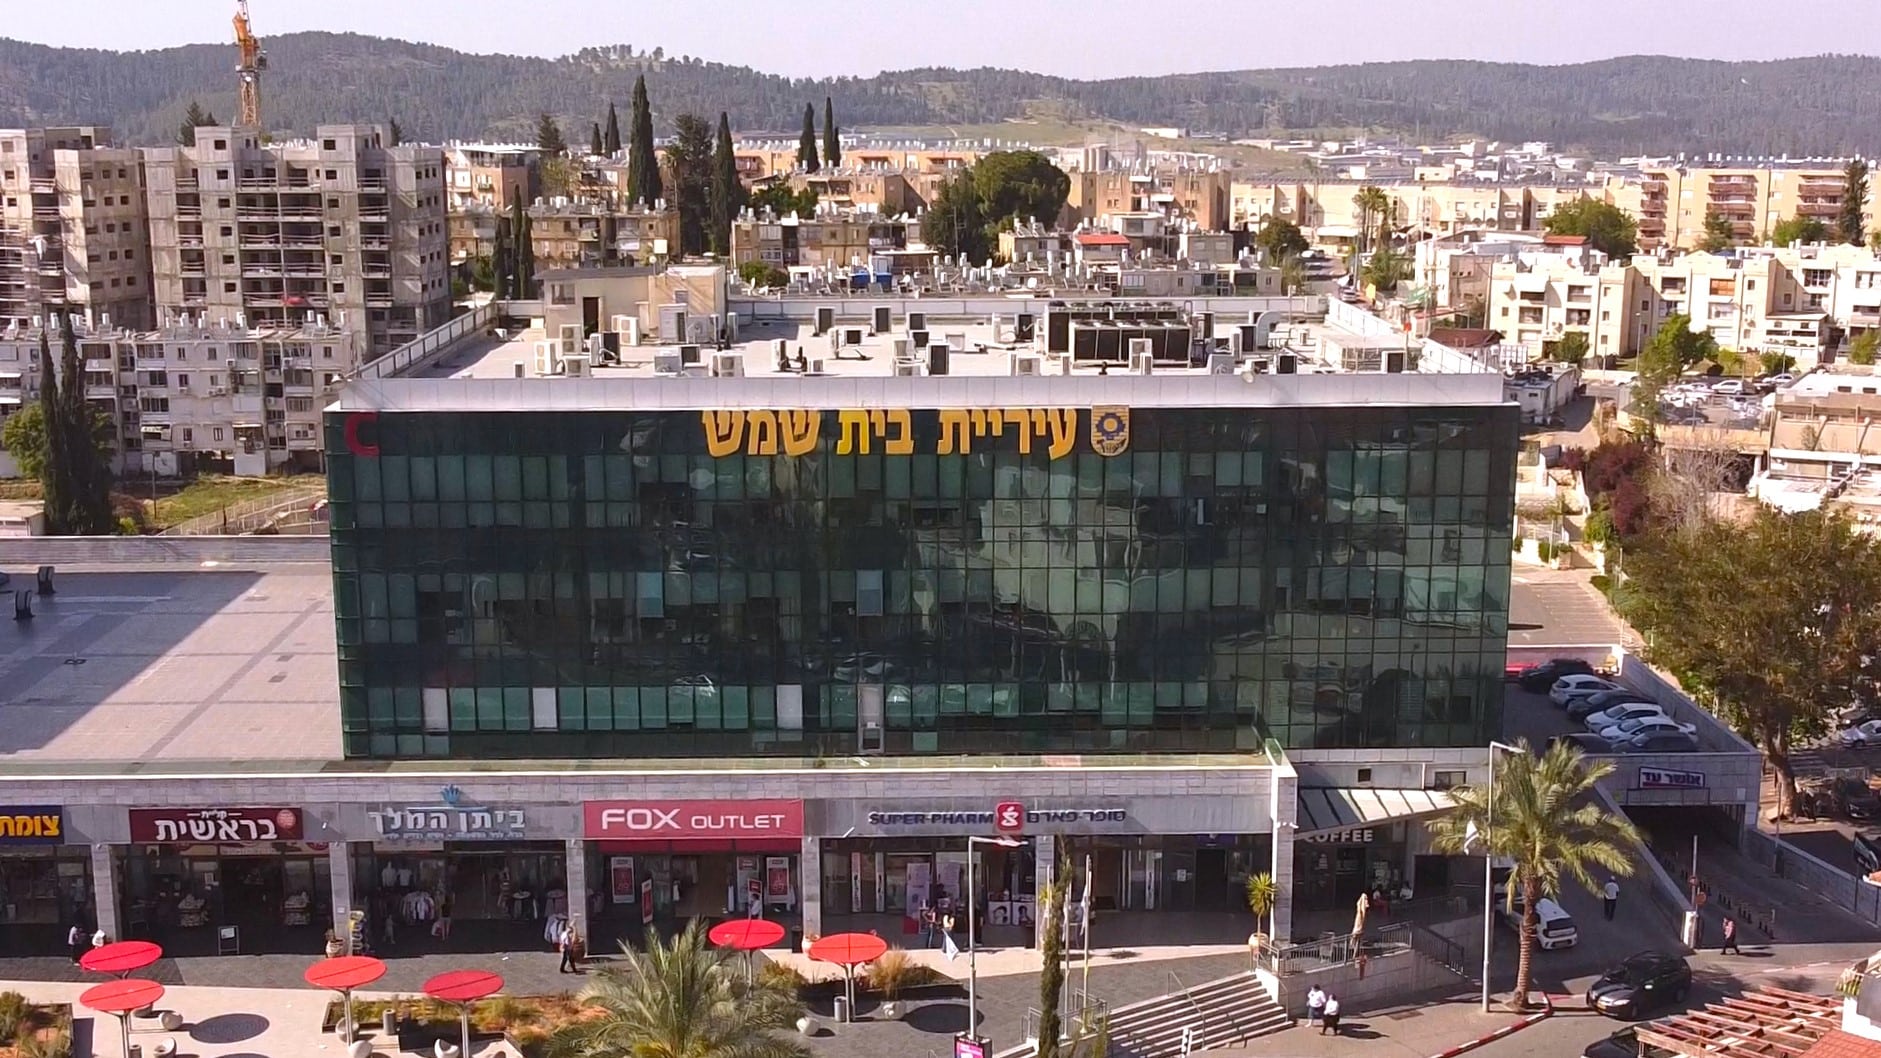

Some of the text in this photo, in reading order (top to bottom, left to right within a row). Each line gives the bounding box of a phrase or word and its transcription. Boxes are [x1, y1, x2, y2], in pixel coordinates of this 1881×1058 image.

[702, 409, 1078, 460] עיריית בית שמש
[0, 815, 60, 837] צומת
[367, 807, 526, 834] ביתן המלך
[602, 808, 785, 830] FOX OUTLET
[868, 811, 994, 825] SUPER-PHARM
[1026, 809, 1126, 823] סופר-פארם
[154, 819, 278, 840] בראשית
